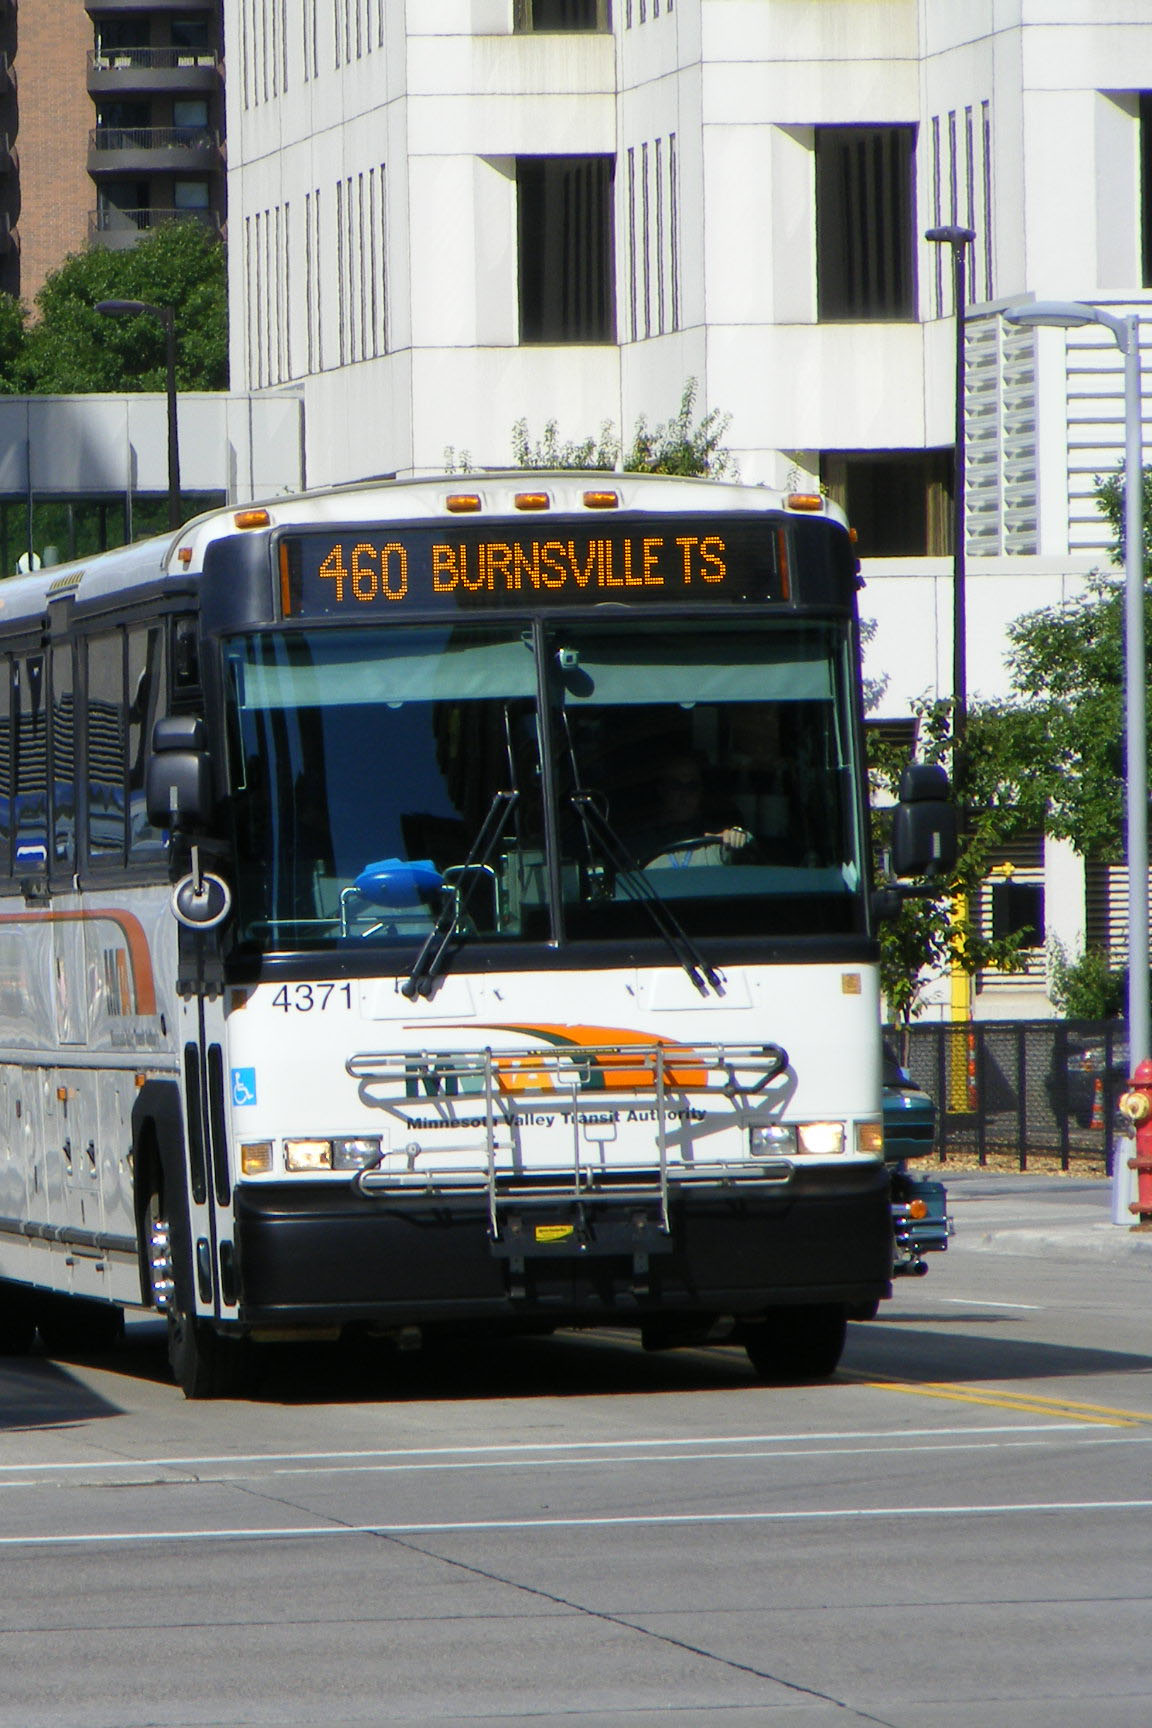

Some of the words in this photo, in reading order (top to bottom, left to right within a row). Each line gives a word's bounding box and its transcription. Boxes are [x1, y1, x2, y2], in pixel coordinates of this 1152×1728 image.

[318, 541, 409, 602] 460
[431, 537, 665, 593] BURNSVILLE
[675, 535, 727, 584] TS
[271, 982, 352, 1013] 4371
[504, 1112, 556, 1127] Valley
[560, 1110, 620, 1124] Transit
